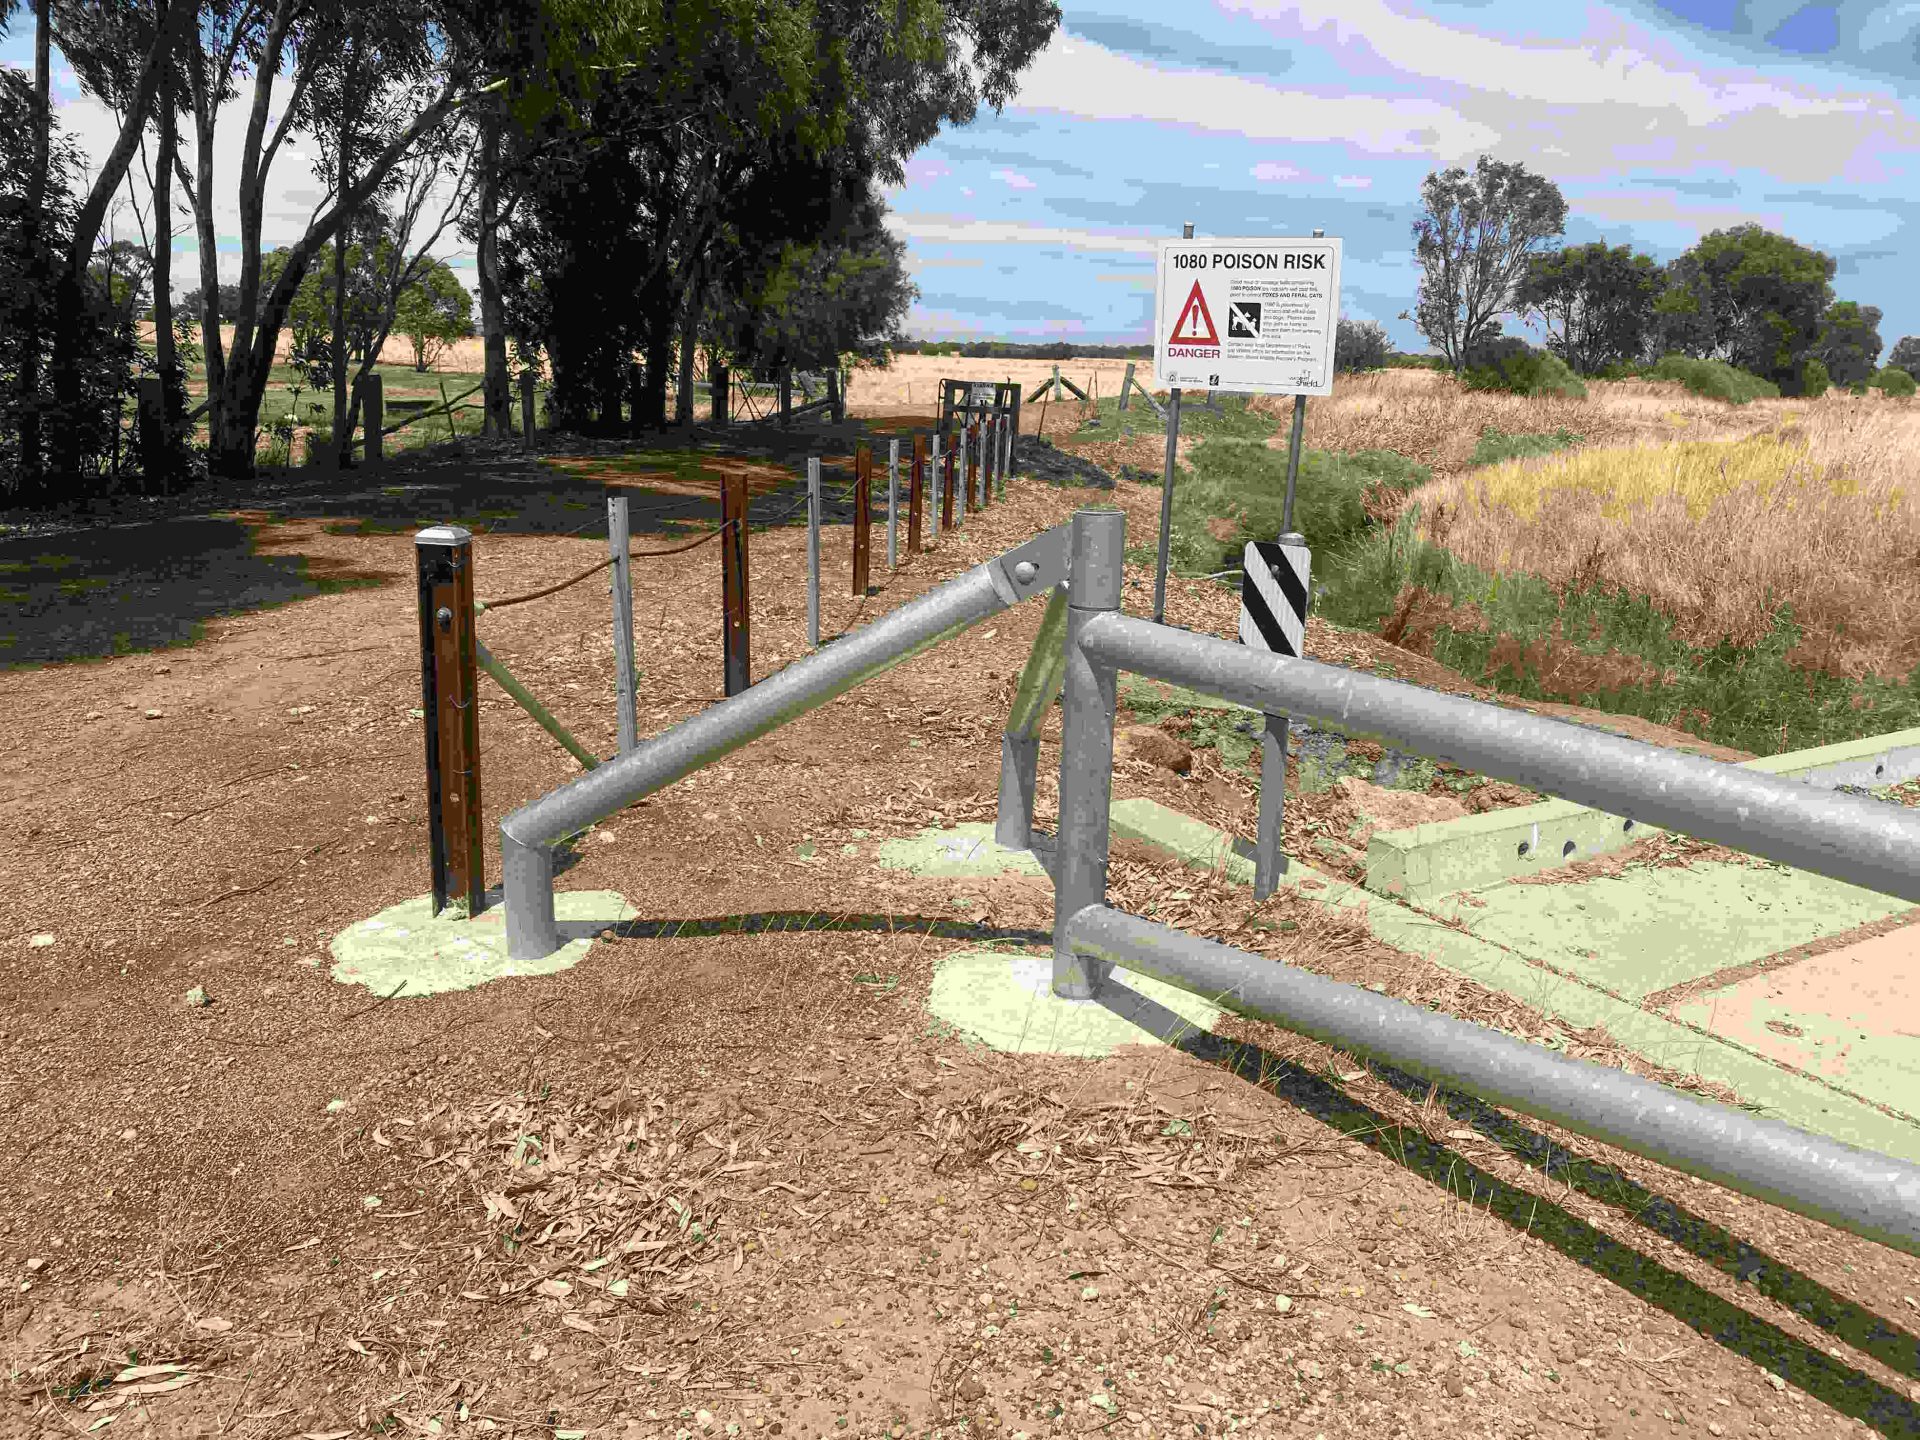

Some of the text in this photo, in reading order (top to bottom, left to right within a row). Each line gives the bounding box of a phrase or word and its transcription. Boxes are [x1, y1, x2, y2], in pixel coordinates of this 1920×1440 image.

[1173, 254, 1327, 270] 1080 POISON RISK
[1168, 347, 1220, 359] DANGER
